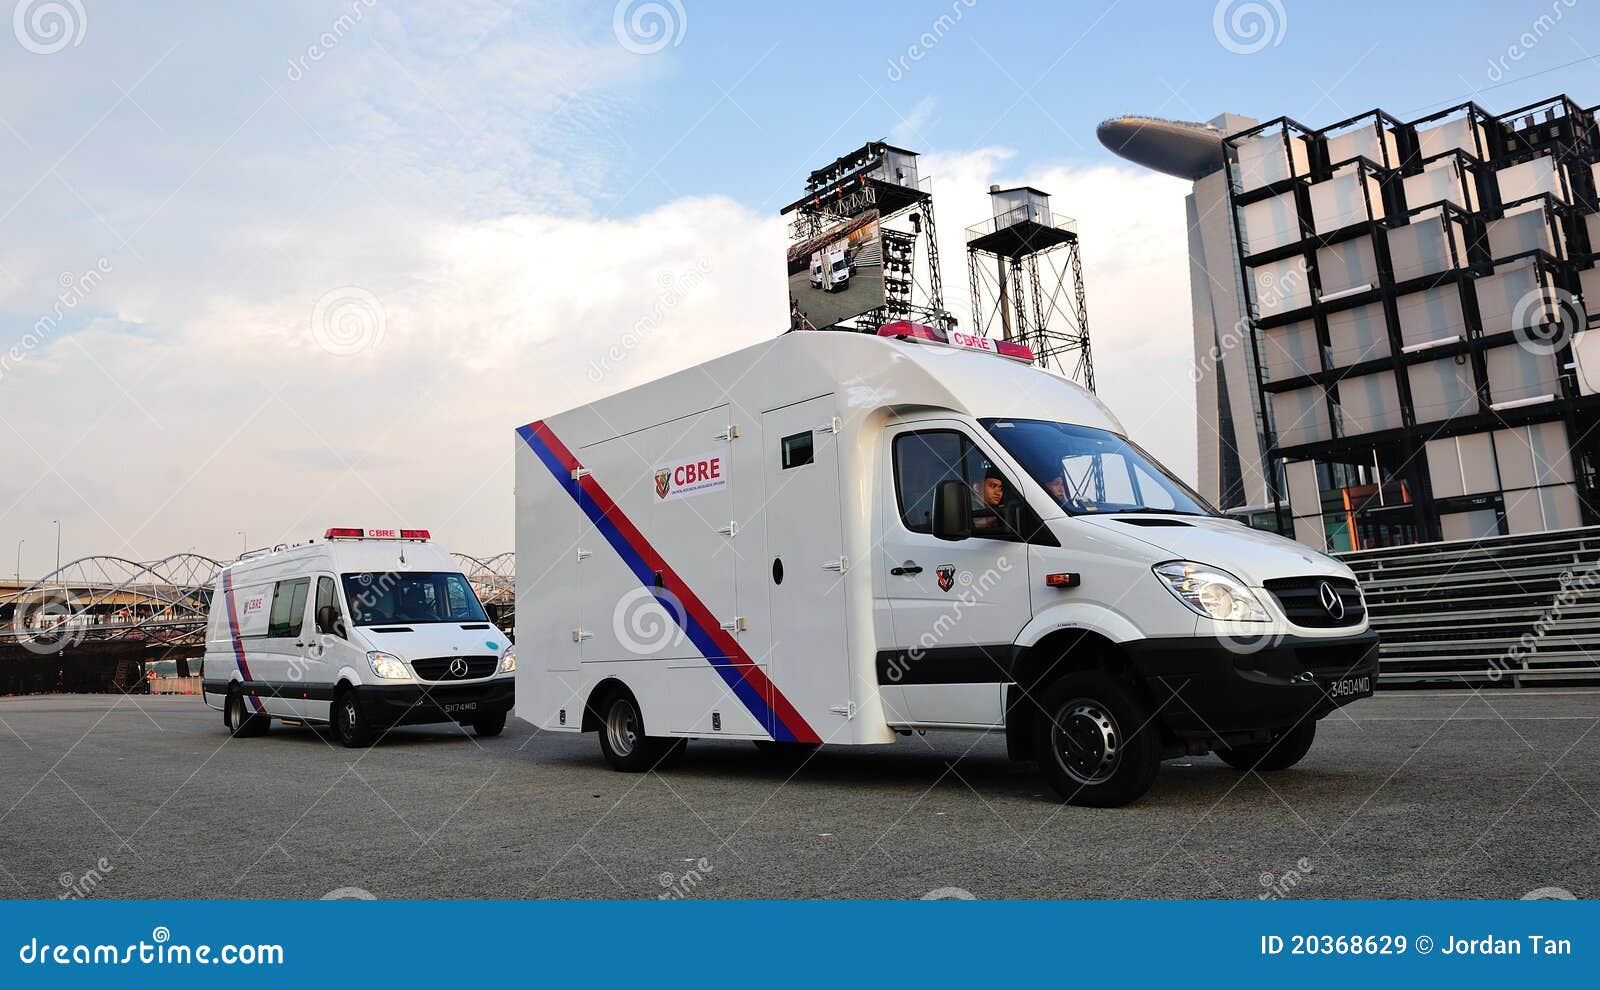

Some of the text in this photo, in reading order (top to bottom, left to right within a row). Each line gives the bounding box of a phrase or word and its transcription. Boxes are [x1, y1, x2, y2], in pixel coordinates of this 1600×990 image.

[954, 332, 991, 350] CBRE
[674, 457, 720, 486] CBRE
[368, 529, 396, 537] CBRE
